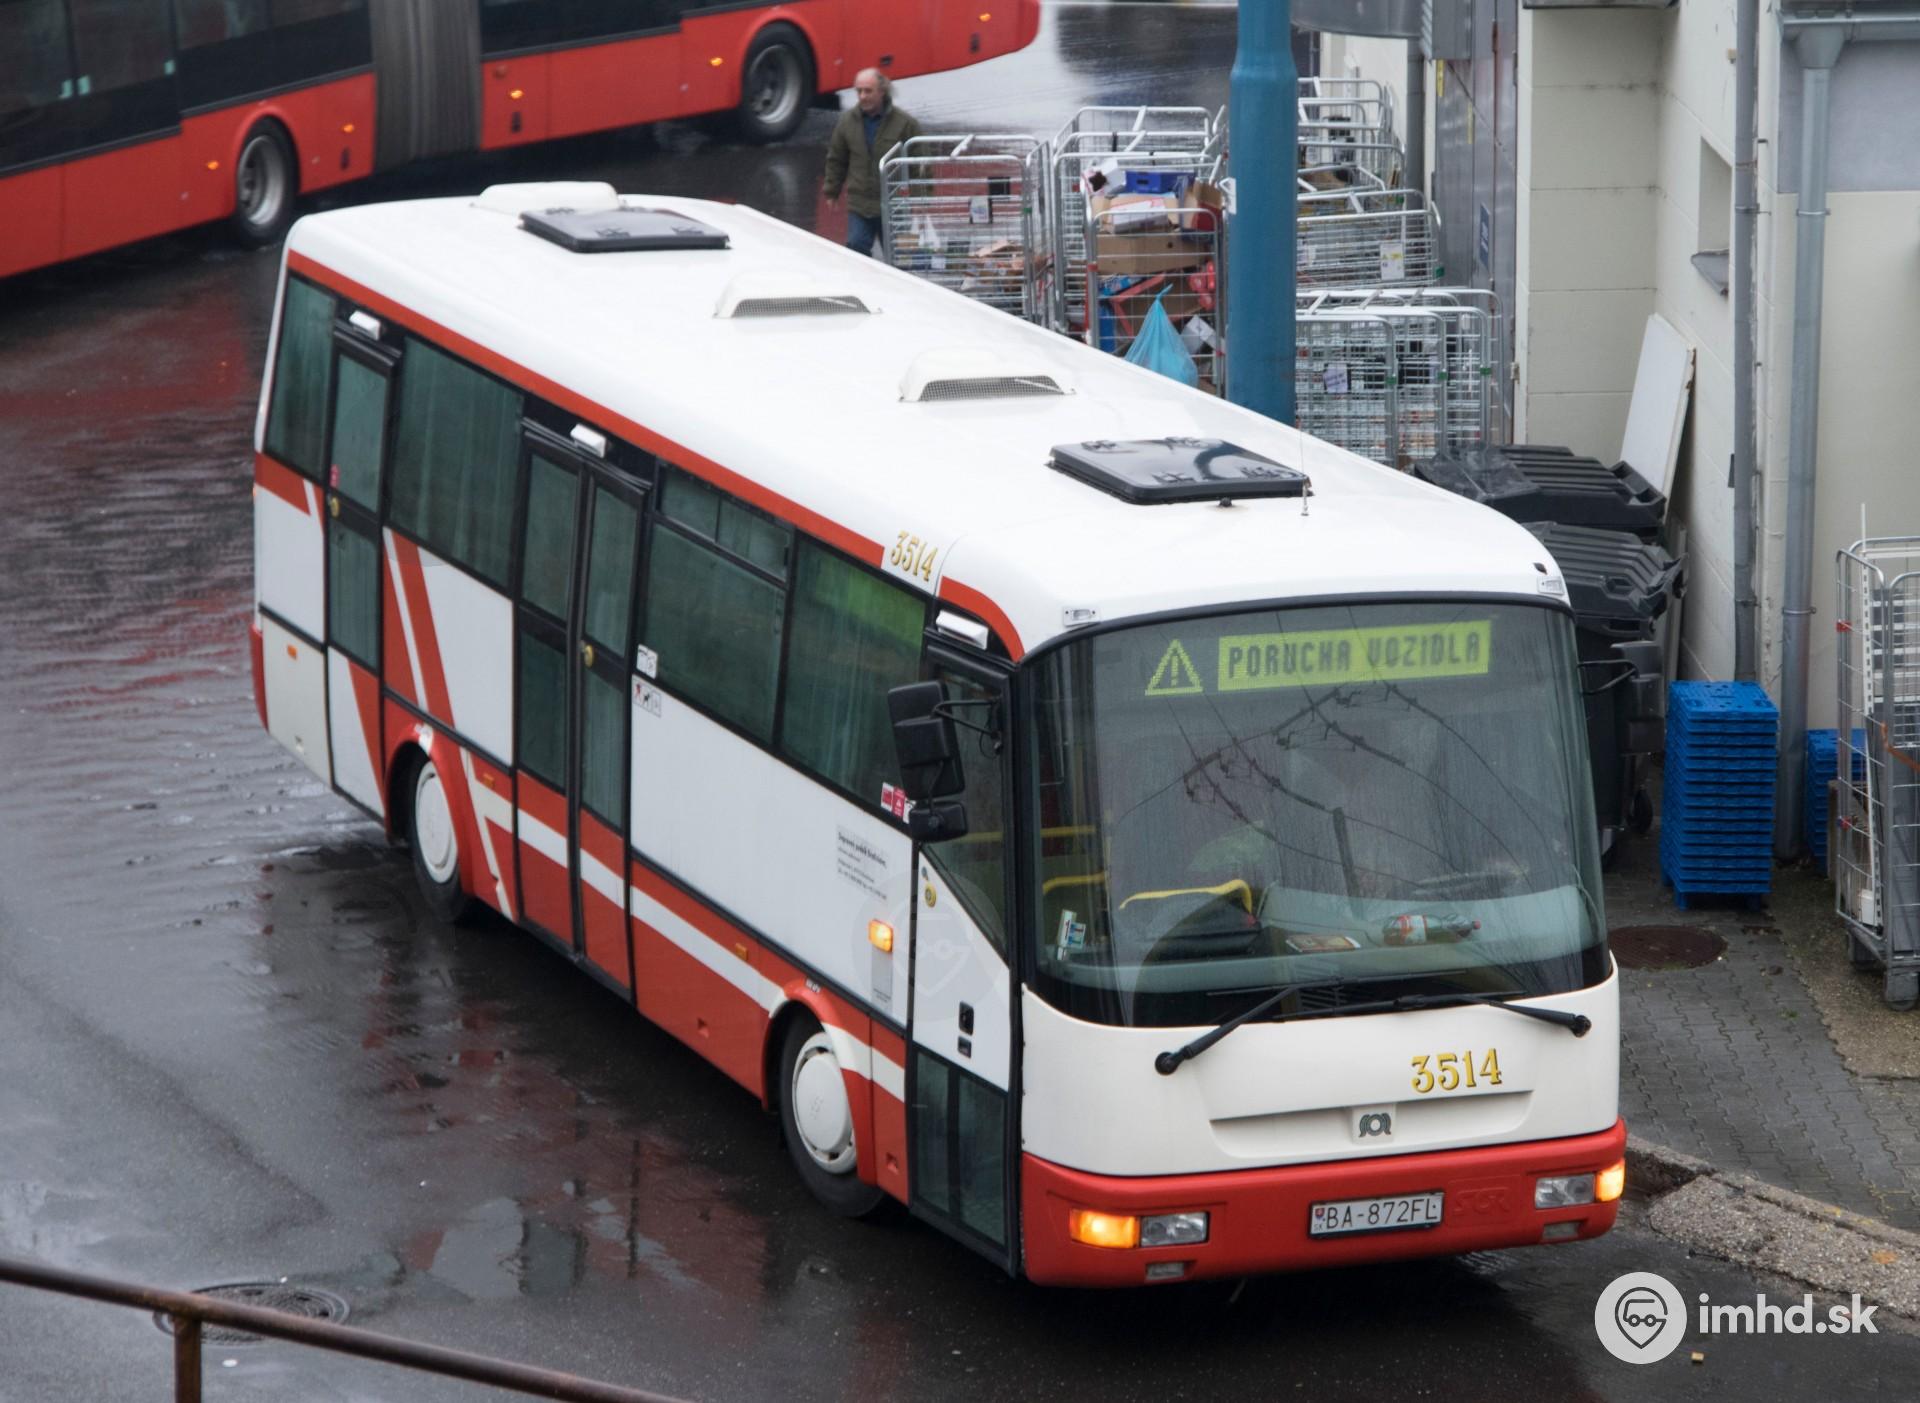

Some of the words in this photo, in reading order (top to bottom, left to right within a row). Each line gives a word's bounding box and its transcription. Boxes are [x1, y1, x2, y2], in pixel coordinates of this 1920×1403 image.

[890, 530, 938, 582] 3514
[1229, 641, 1350, 679] PORUCHA
[1368, 631, 1480, 669] VOZIDLA
[1411, 1048, 1502, 1093] 3514
[1326, 1198, 1438, 1229] BA-872FL
